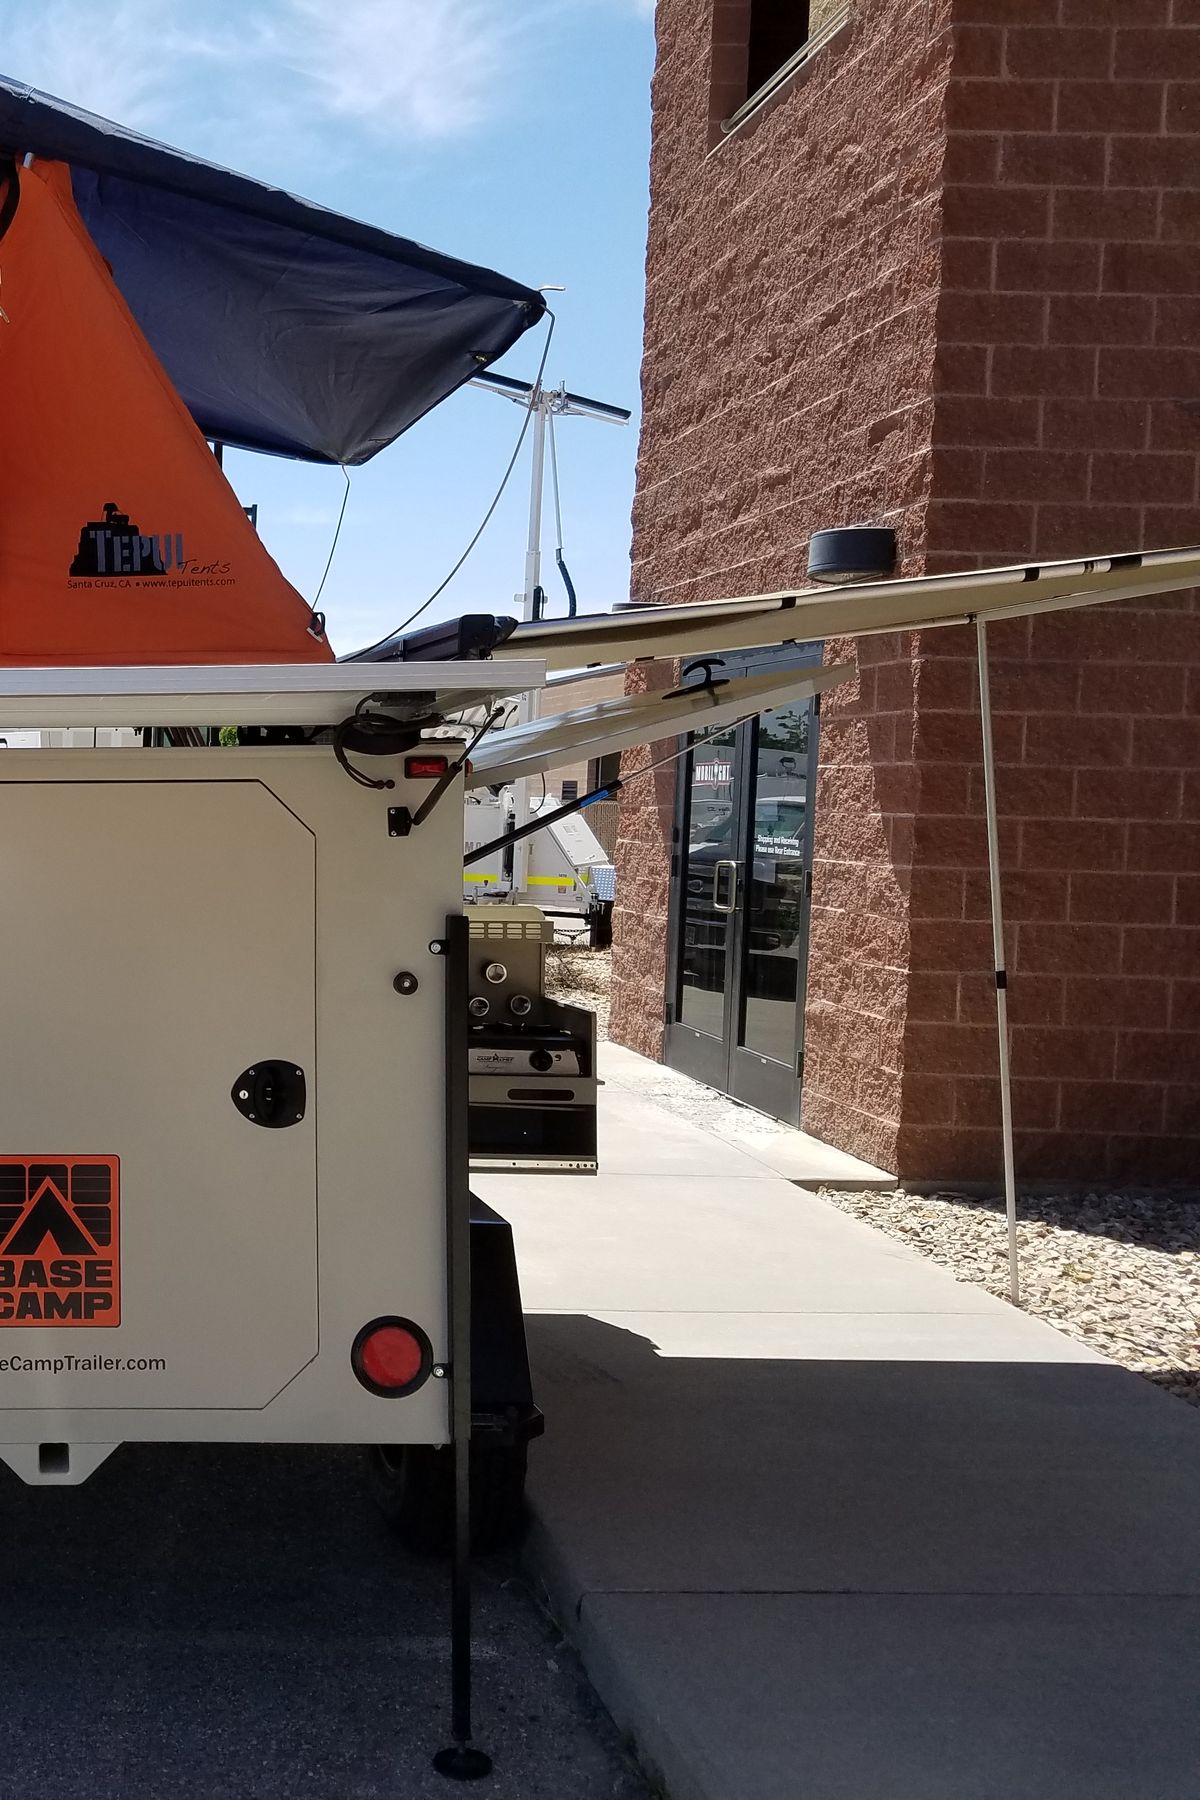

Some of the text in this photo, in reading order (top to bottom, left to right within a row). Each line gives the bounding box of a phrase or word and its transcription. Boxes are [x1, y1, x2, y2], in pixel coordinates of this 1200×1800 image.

[90, 530, 184, 572] TEPUI
[178, 559, 231, 575] Tents
[67, 577, 236, 590] Santa Cruz, CA www.tepuitents.com
